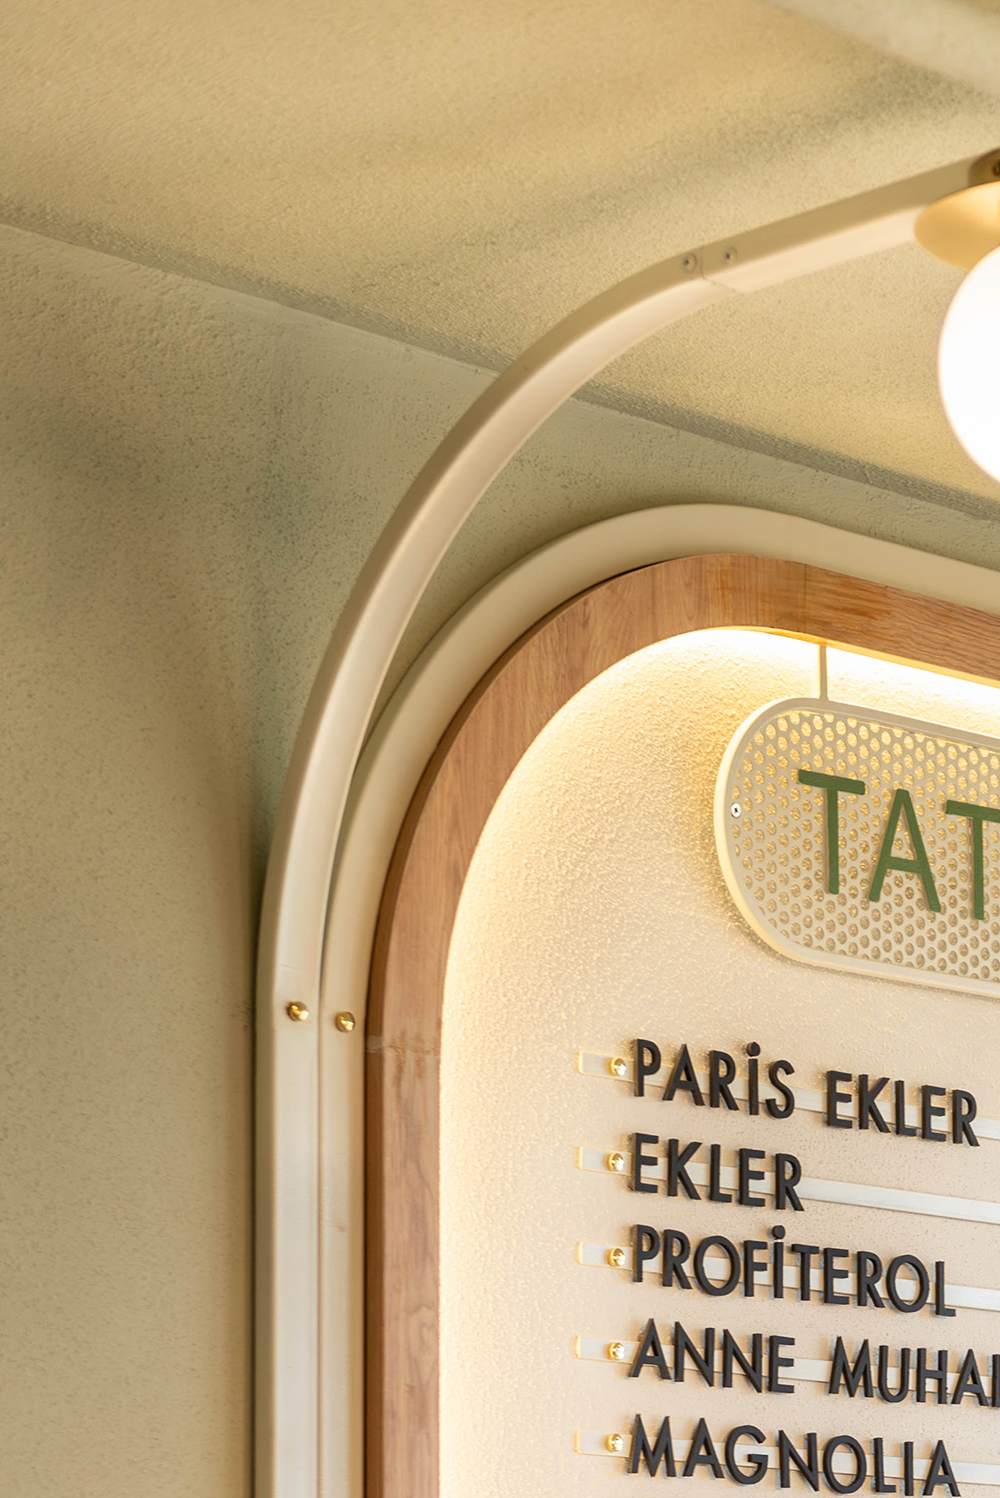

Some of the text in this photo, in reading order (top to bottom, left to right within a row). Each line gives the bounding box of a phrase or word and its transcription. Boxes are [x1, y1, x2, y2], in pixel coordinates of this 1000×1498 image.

[633, 1038, 980, 1146] PARİS EKLER
[627, 1132, 805, 1211] EKLER
[632, 1224, 956, 1316] PROFİTEROL
[627, 1318, 795, 1393] ANNE
[627, 1414, 961, 1497] MAGNOLIA
